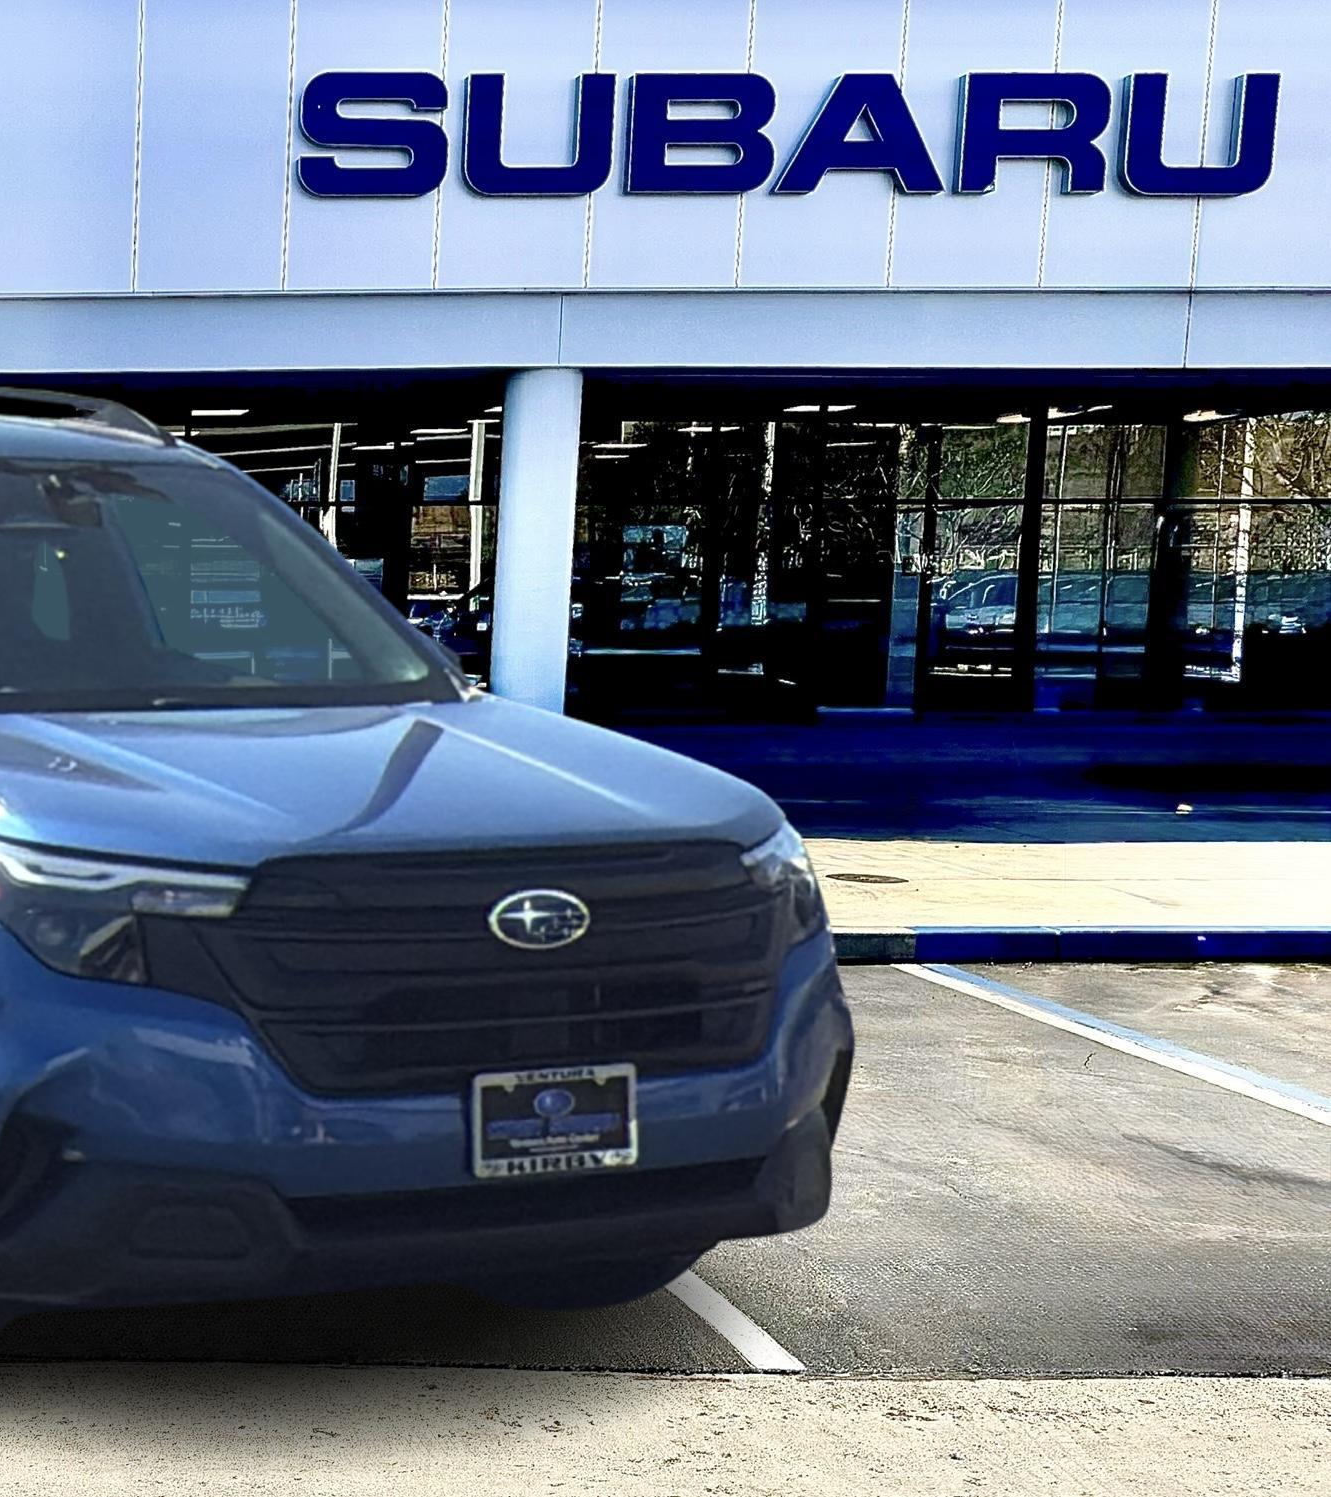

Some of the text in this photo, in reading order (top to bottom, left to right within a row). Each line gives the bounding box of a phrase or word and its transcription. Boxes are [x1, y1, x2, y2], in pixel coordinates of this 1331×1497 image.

[296, 70, 1282, 197] SUBARU
[515, 1068, 595, 1082] VENTURA
[507, 1154, 605, 1174] KIRBY
